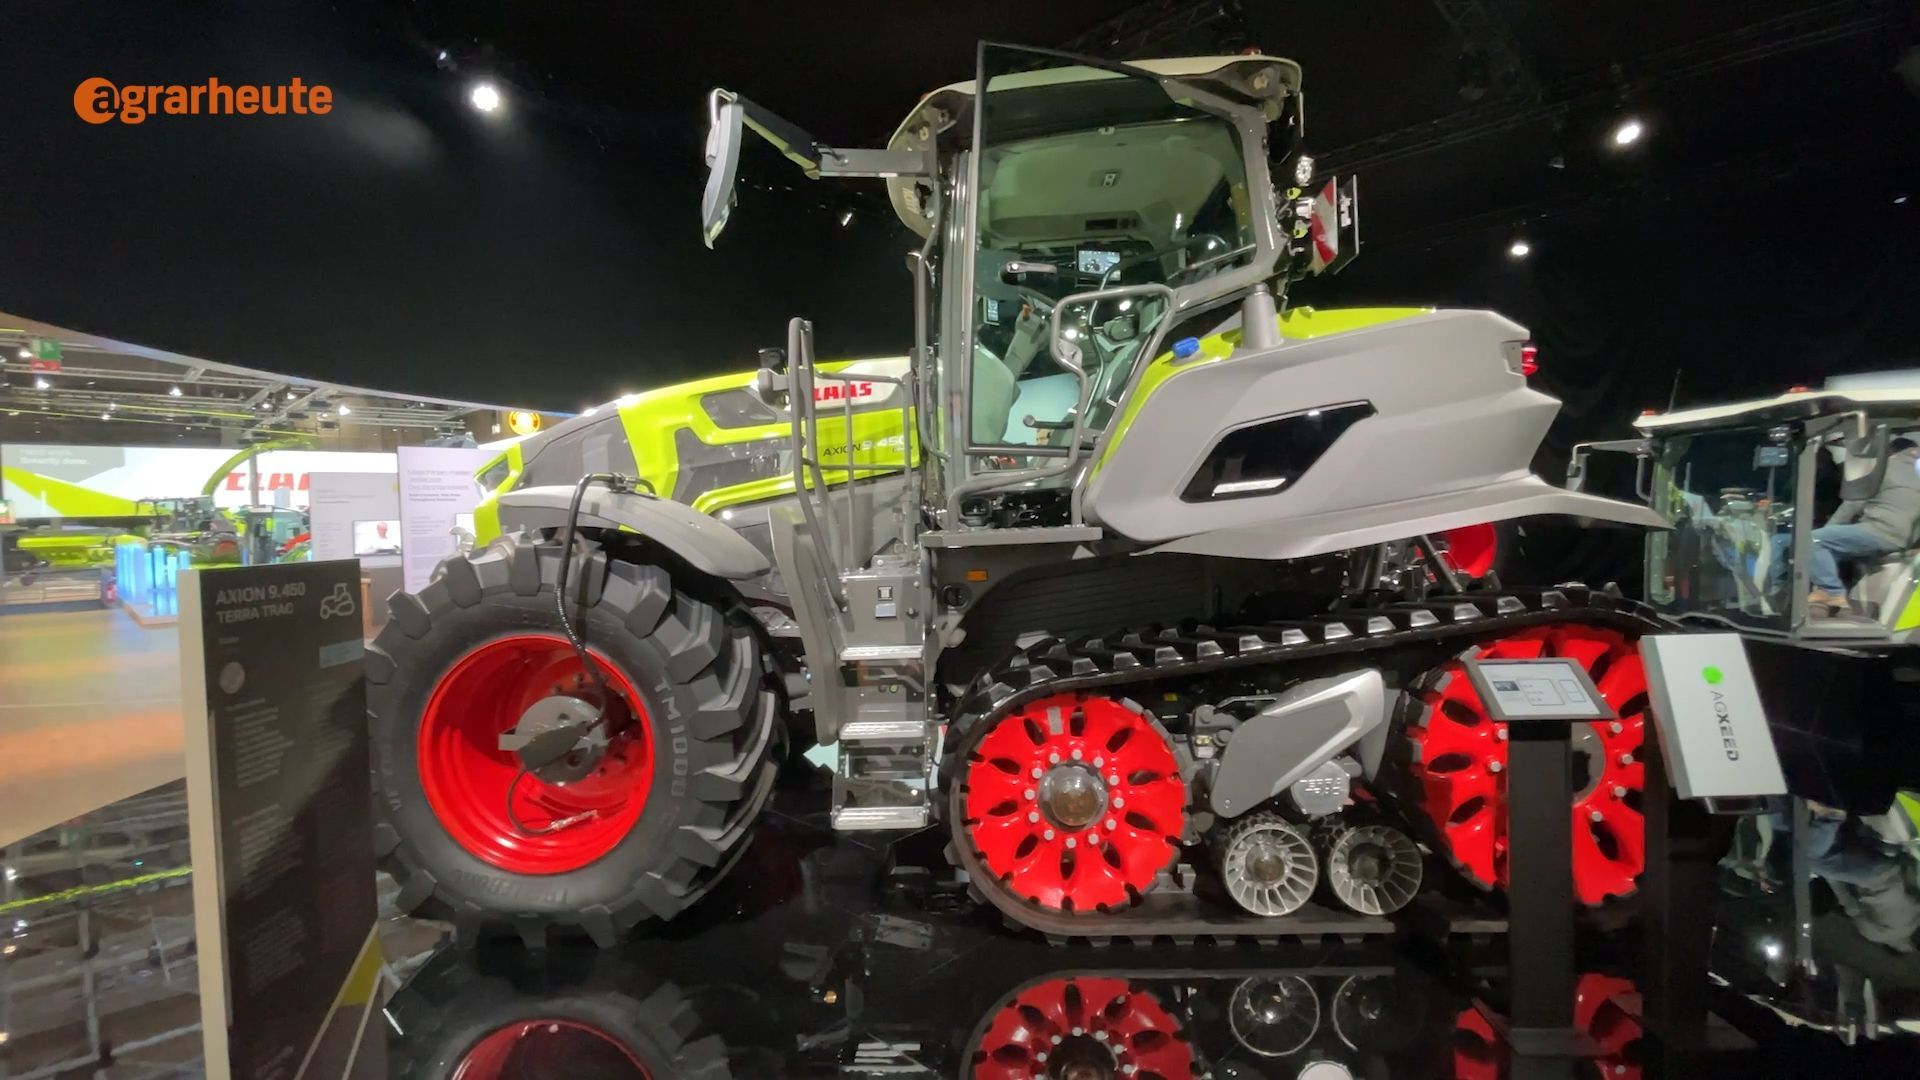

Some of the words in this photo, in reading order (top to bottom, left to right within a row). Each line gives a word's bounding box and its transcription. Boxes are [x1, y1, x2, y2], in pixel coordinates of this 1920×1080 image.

[812, 381, 873, 402] LAAS
[822, 443, 861, 457] AXION
[216, 586, 266, 605] AXION
[268, 582, 307, 602] 9.450
[216, 609, 260, 624] TERRA
[263, 603, 295, 619] TRAC
[654, 676, 689, 798] TM1000
[1709, 690, 1740, 762] AGXEED
